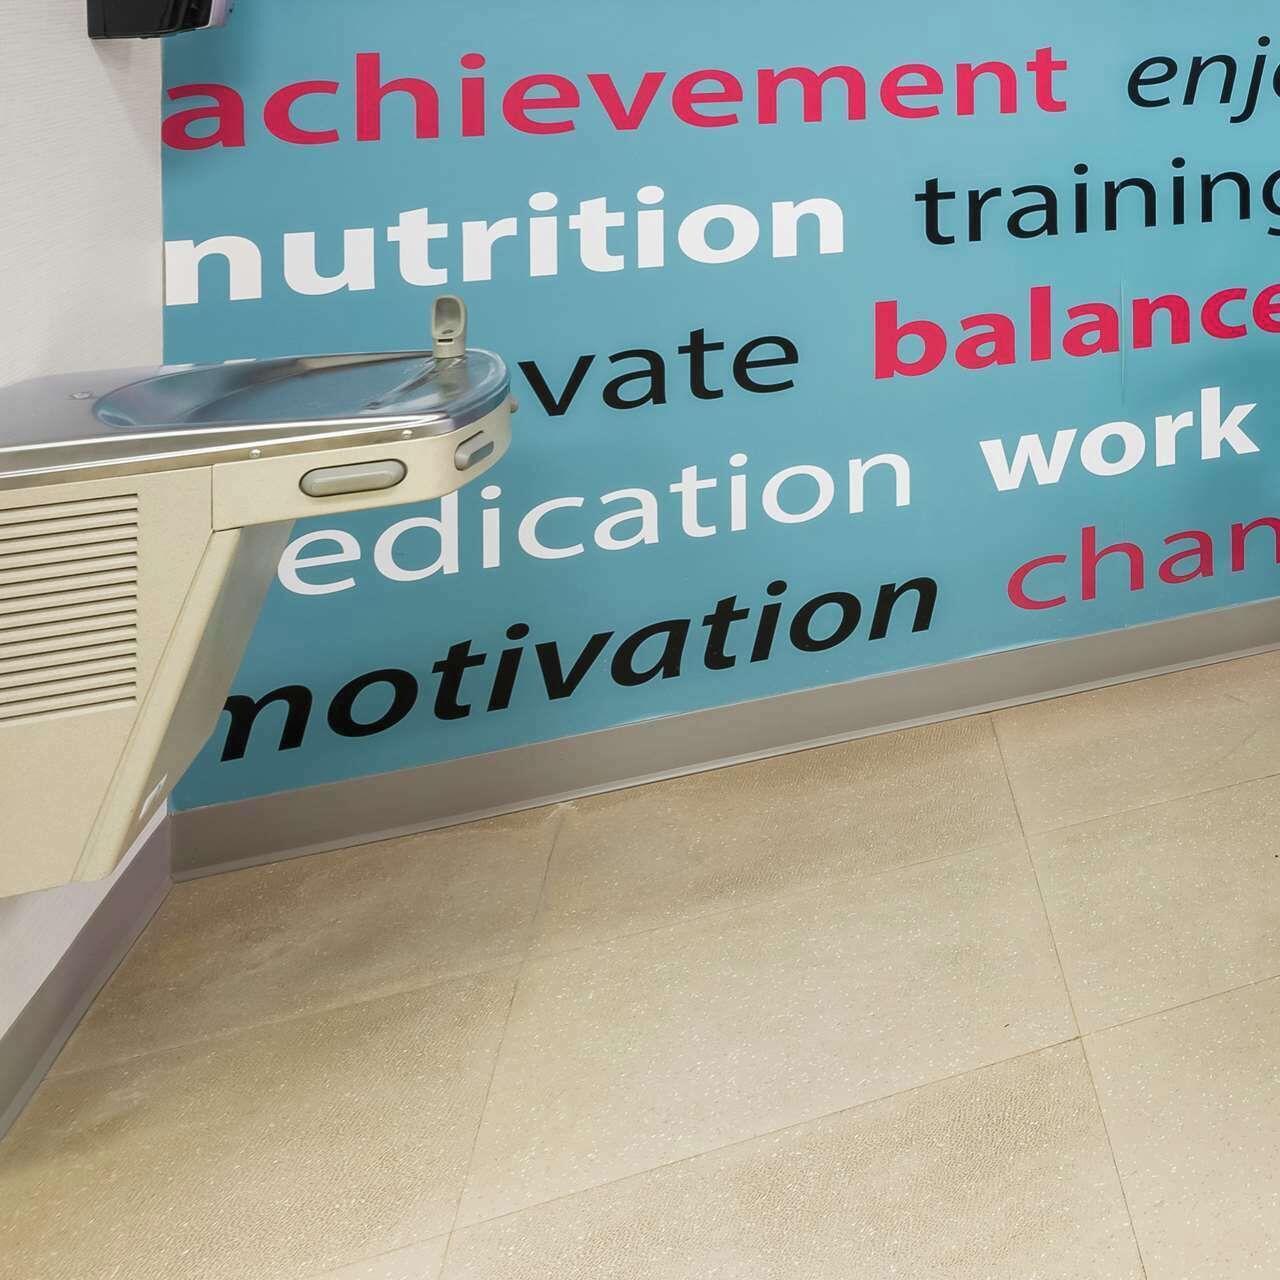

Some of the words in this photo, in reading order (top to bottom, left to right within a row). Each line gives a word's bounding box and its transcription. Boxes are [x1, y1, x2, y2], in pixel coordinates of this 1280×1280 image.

[161, 47, 1068, 151] achievement
[164, 185, 845, 306] nutrition
[277, 451, 911, 596] edication
[979, 387, 1261, 492] work
